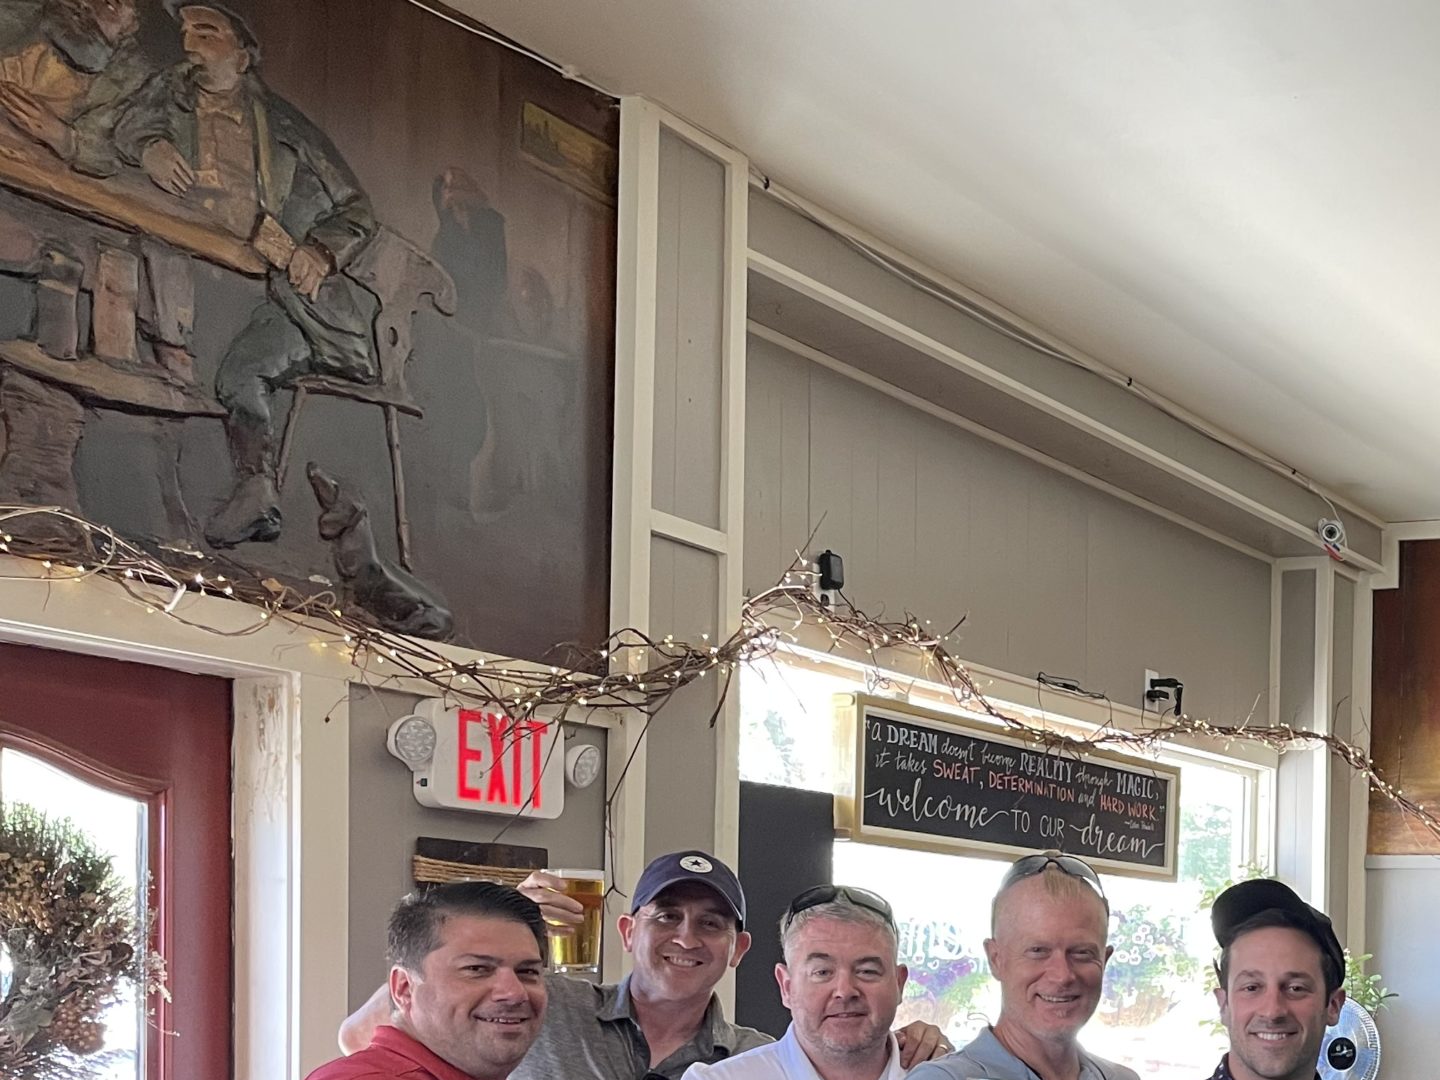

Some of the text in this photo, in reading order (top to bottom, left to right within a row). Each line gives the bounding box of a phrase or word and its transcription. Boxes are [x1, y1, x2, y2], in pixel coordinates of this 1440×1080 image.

[457, 708, 548, 809] EXIT
[875, 747, 891, 768] it
[895, 751, 927, 774] takes
[989, 771, 1075, 803] DETERMINATION
[1078, 788, 1096, 808] and
[1100, 793, 1125, 816] HARD
[887, 725, 938, 754] DREAM
[1020, 752, 1073, 783] REALITY
[864, 778, 1165, 858] welcome TO OUR dream
